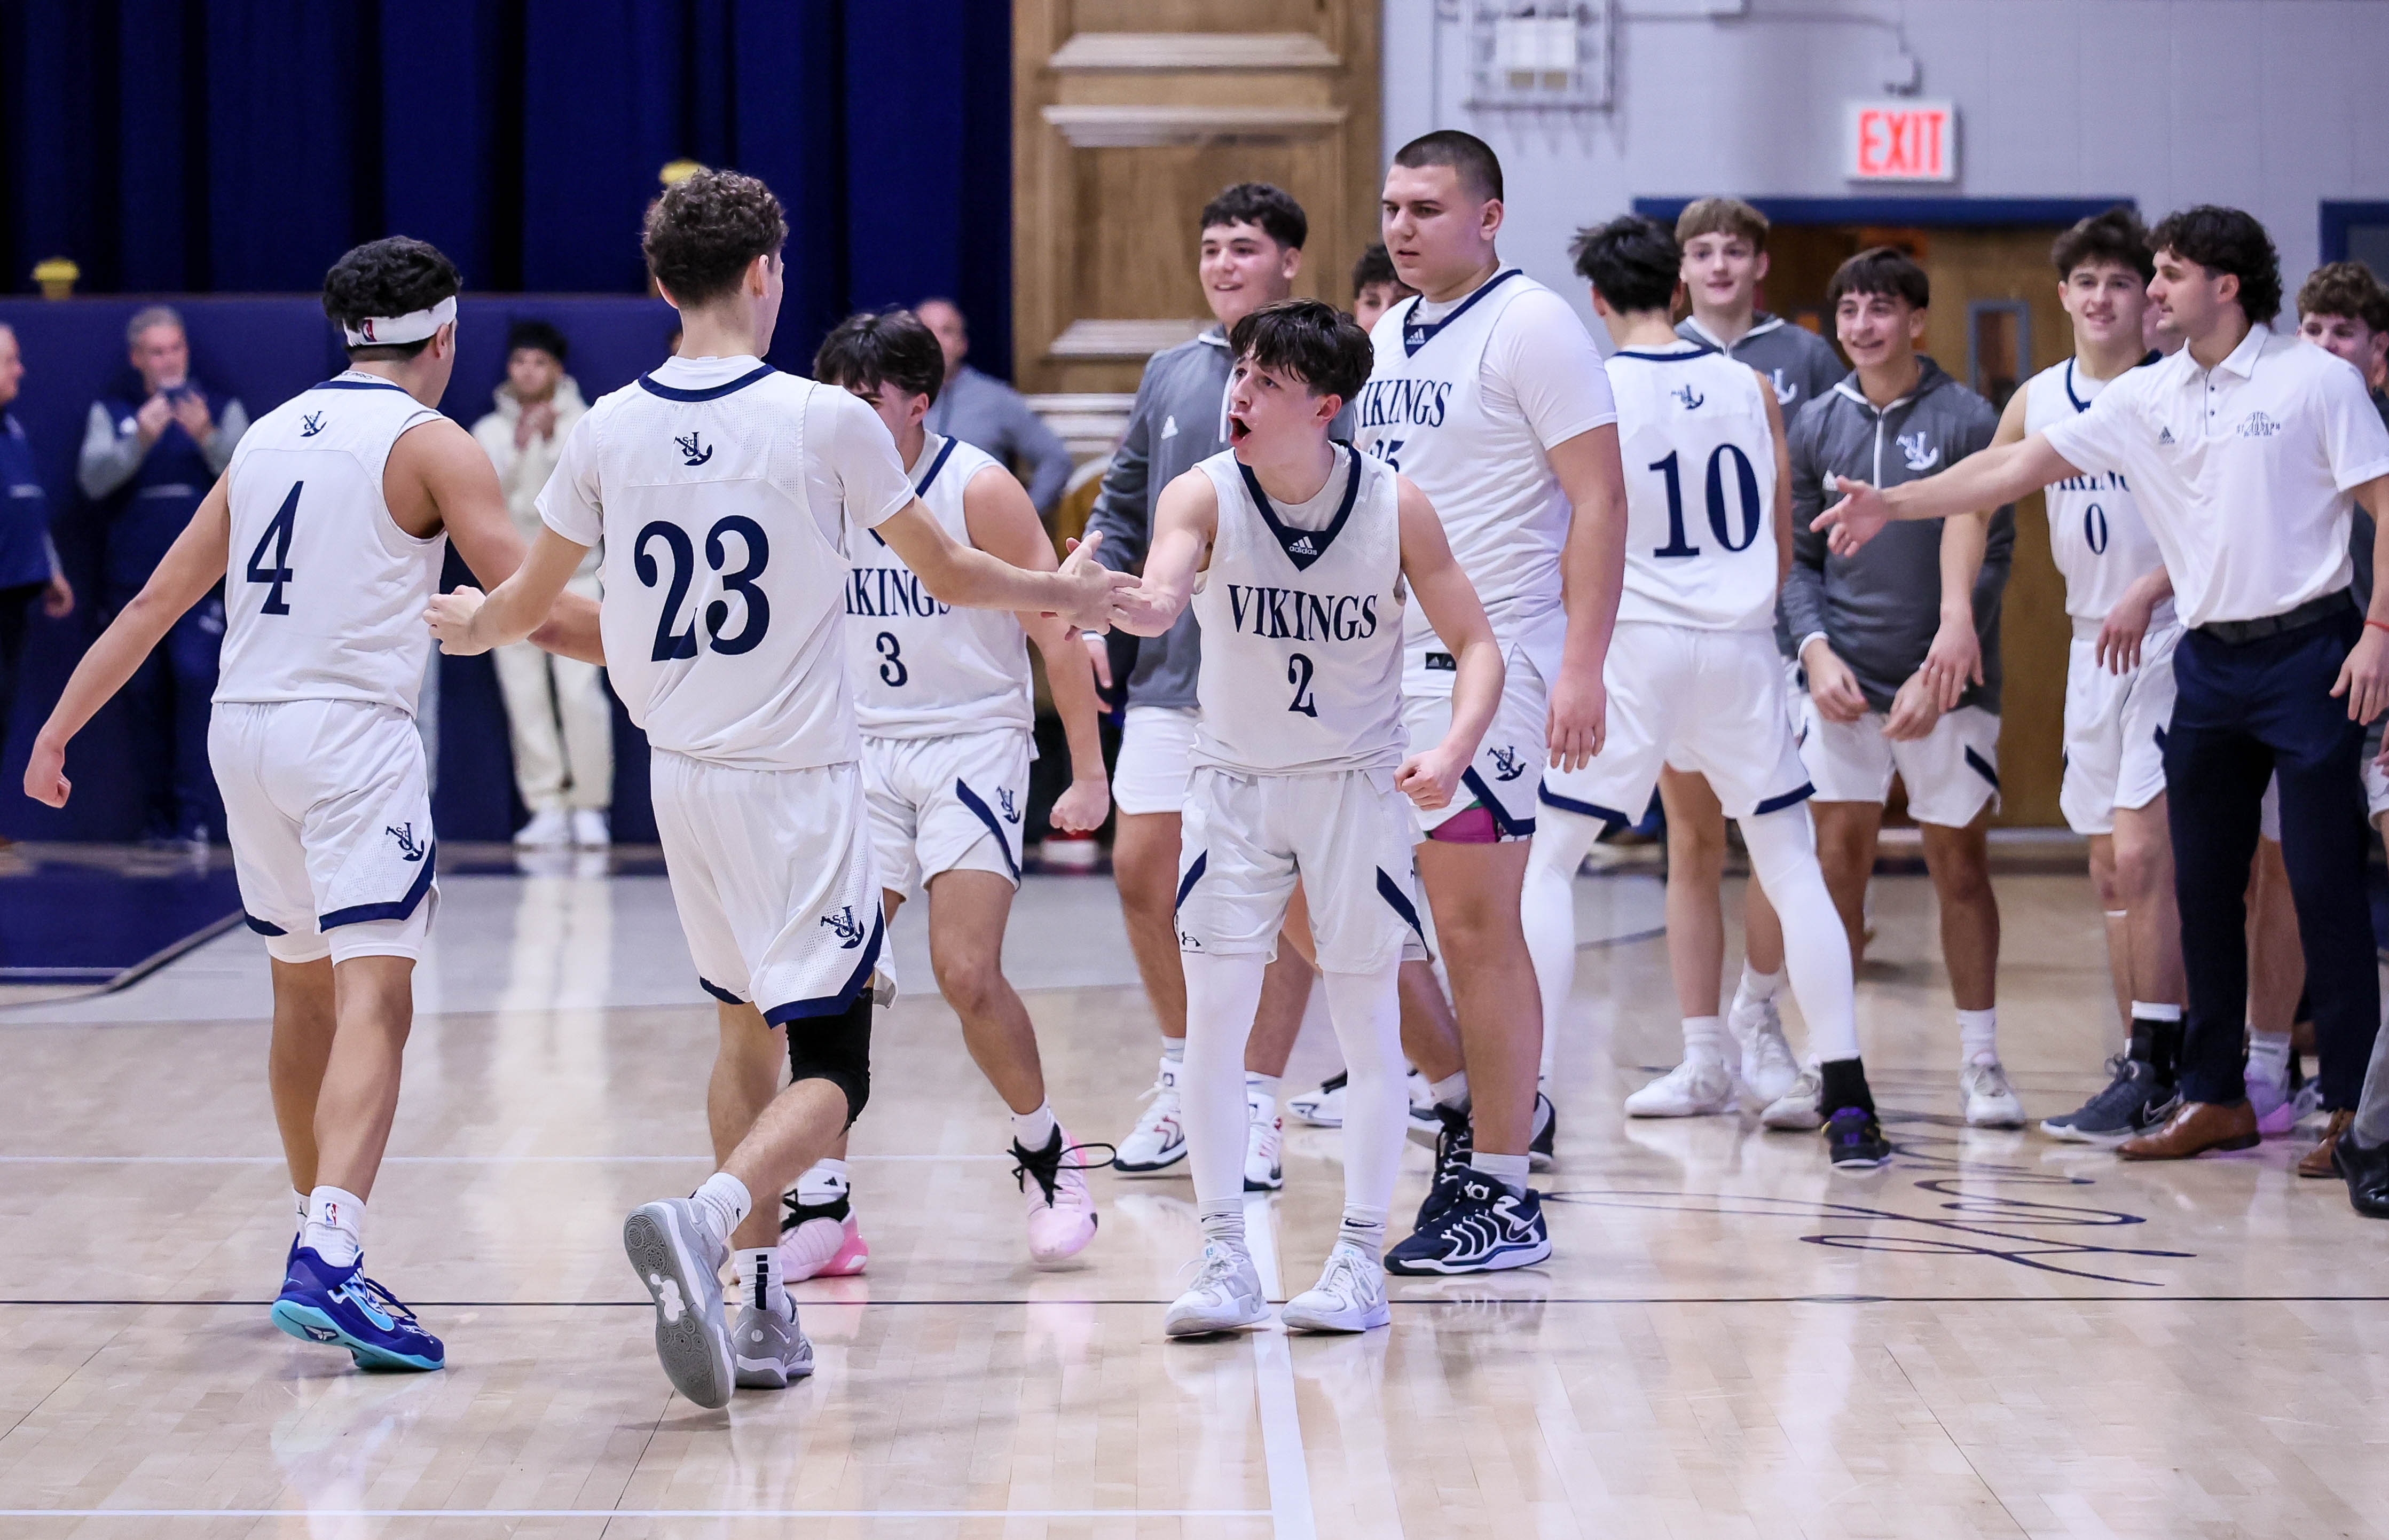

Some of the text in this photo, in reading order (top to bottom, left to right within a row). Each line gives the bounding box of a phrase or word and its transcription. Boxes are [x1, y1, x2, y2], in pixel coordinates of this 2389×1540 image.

[1858, 110, 1945, 176] EXIT
[1354, 379, 1452, 427] IKINGS
[1648, 444, 1761, 557] 10
[2084, 502, 2107, 555] 0
[247, 481, 303, 616] 4
[1289, 546, 1317, 556] adidas
[634, 515, 770, 662] 23
[1227, 585, 1378, 642] VIKINGS
[876, 631, 908, 687] 3
[1288, 653, 1318, 718] 2
